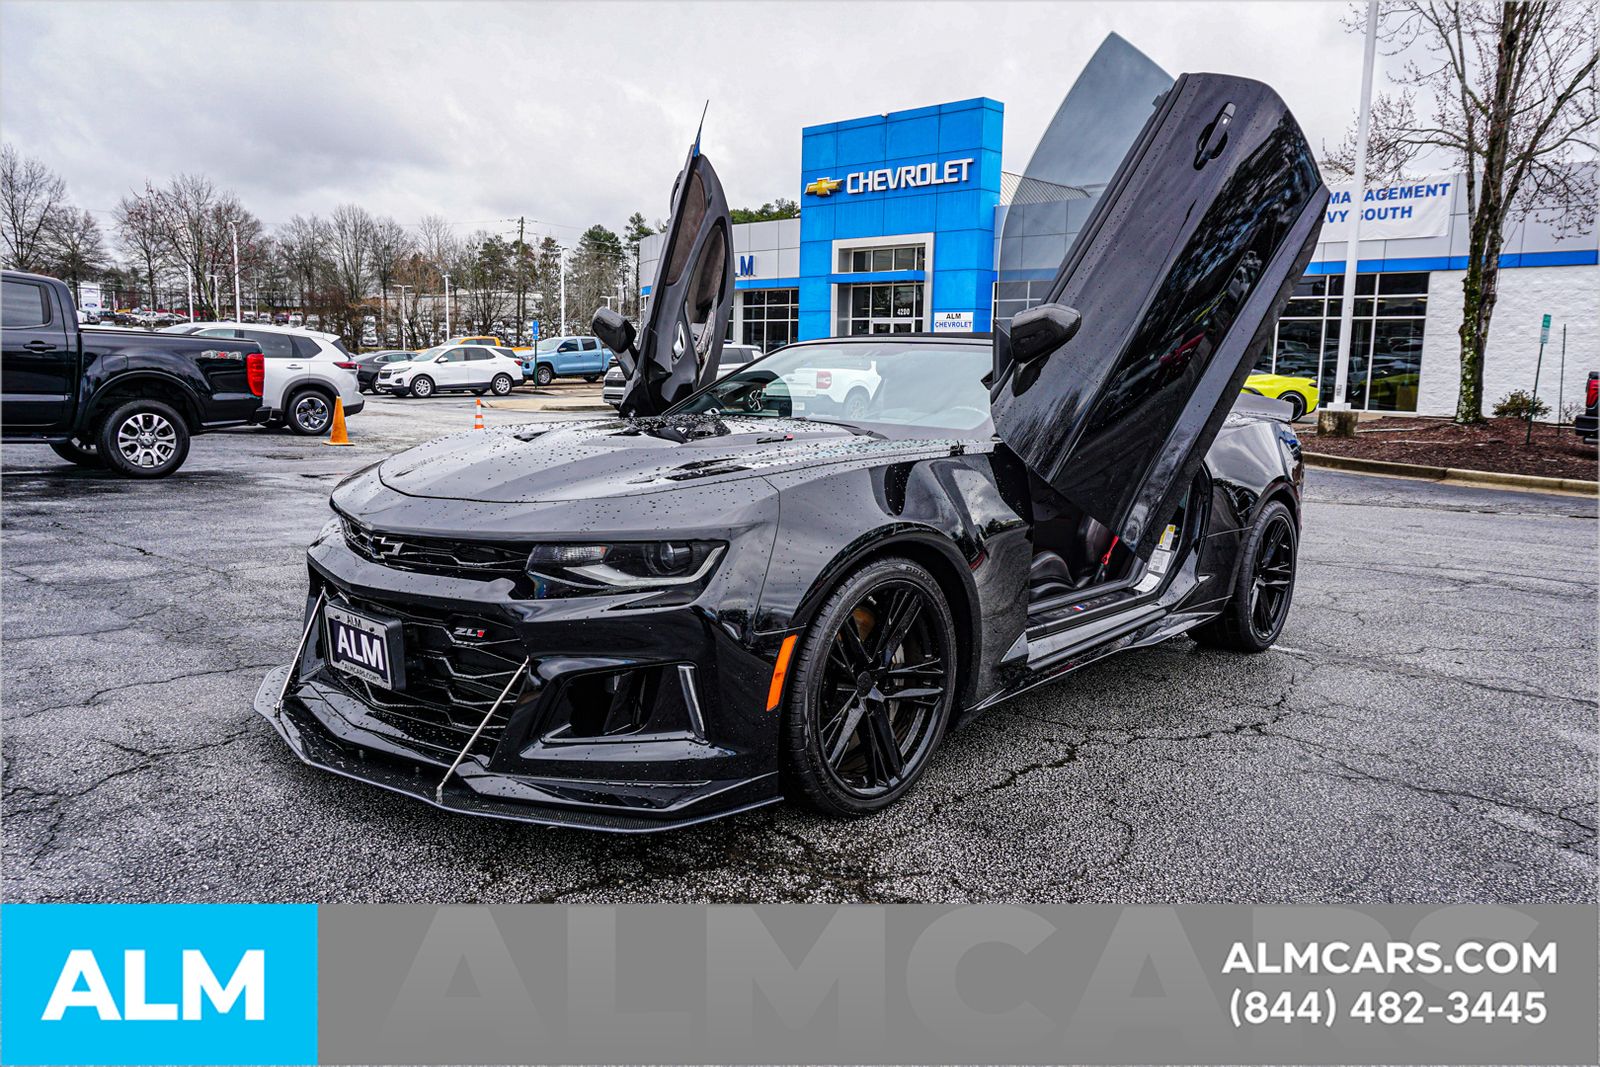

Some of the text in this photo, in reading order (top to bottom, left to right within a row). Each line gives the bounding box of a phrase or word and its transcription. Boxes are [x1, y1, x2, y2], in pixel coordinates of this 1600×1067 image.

[846, 157, 974, 194] CHEVROLET
[1329, 183, 1451, 204] MAAGEMENT
[337, 625, 385, 671] ALM
